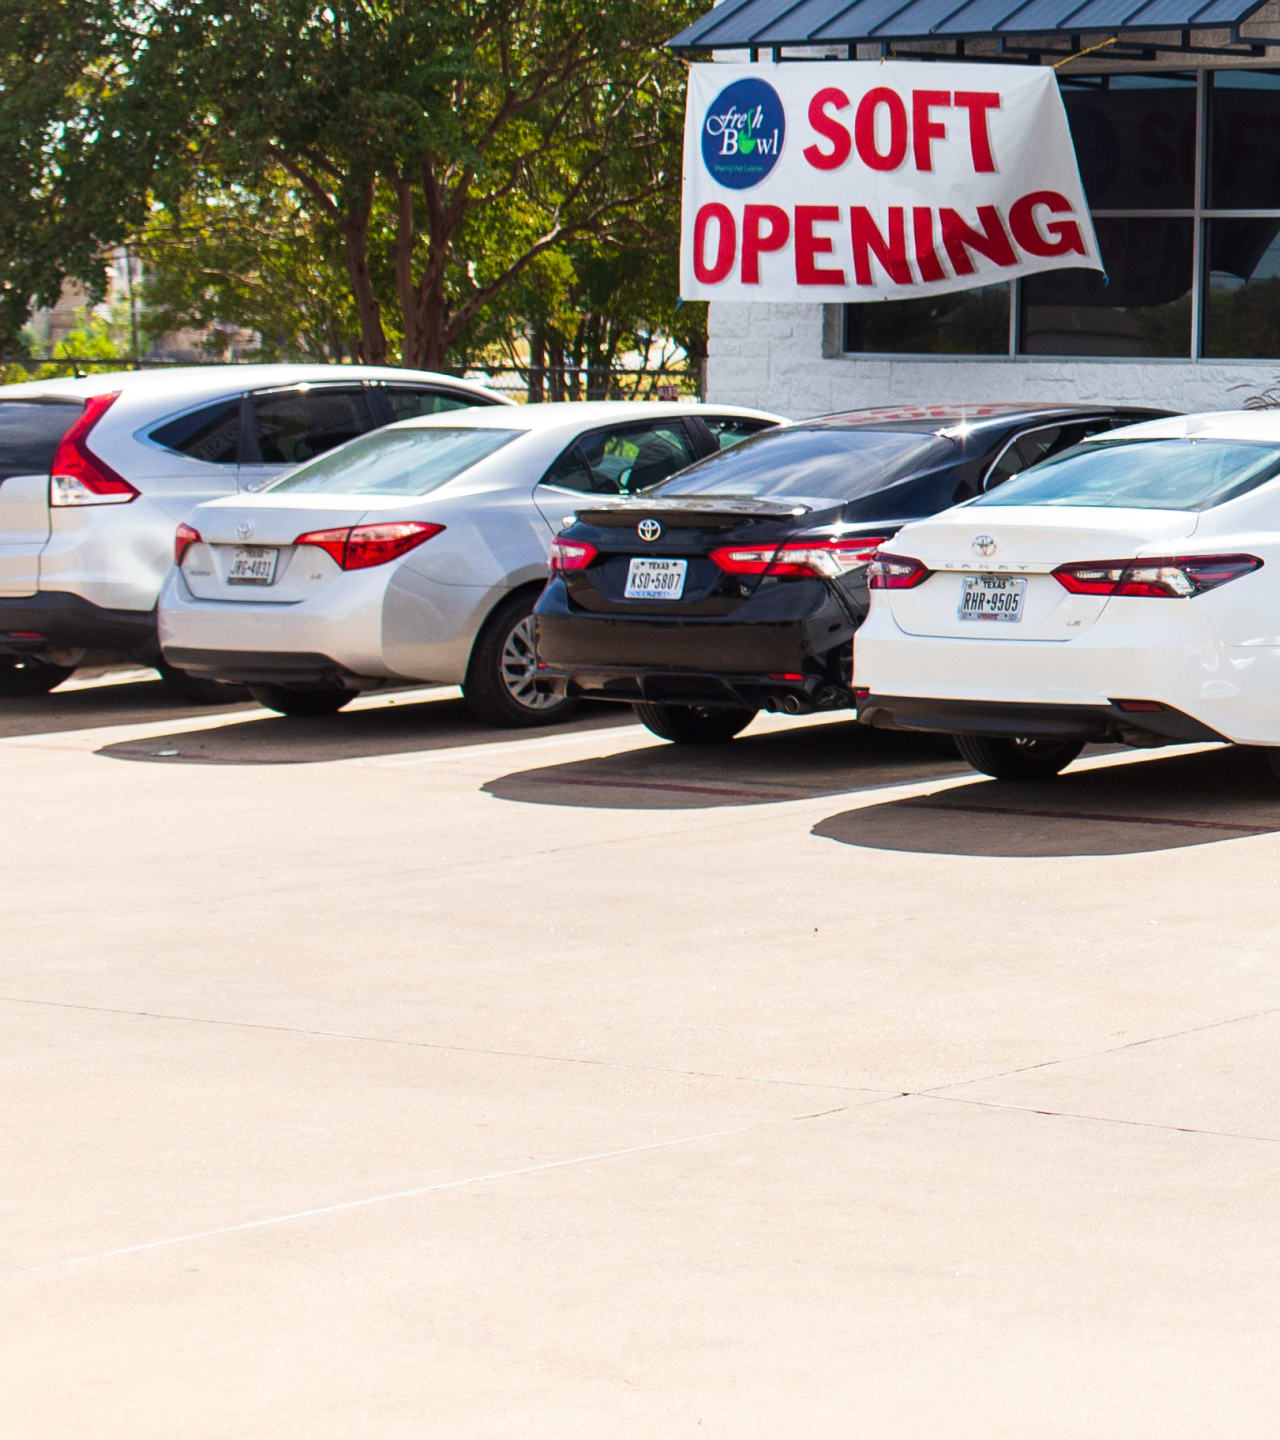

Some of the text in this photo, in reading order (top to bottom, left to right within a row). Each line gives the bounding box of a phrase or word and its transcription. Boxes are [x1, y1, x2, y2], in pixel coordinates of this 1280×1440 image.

[803, 87, 1000, 173] SOFT
[693, 190, 1086, 286] OPENING
[983, 581, 1007, 590] TEXAS
